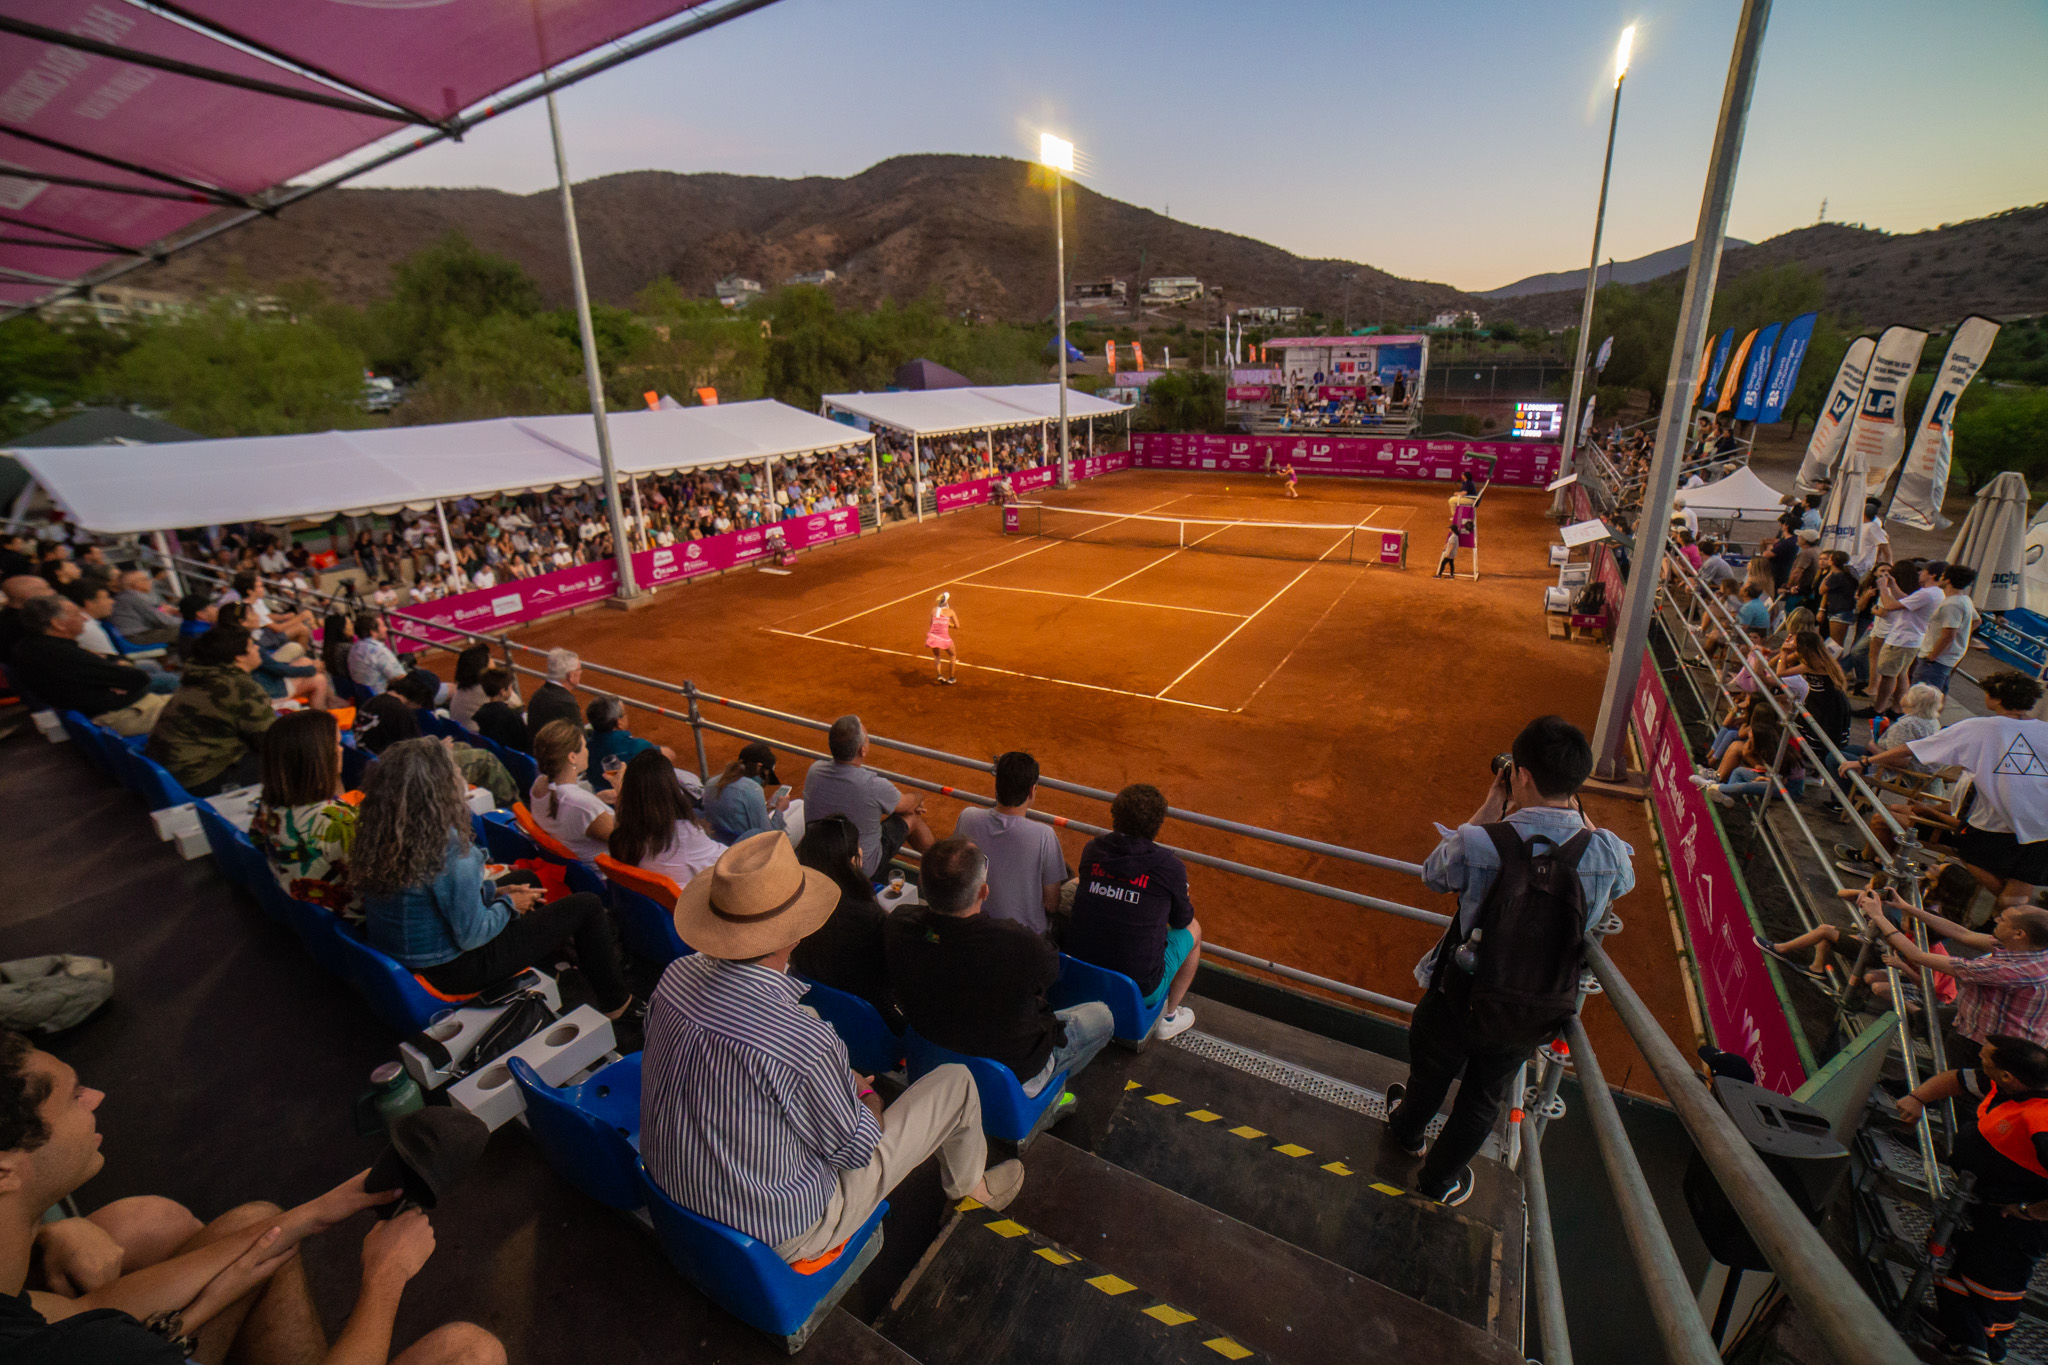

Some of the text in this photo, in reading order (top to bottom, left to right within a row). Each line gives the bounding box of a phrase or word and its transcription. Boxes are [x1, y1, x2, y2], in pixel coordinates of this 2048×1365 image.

[1864, 391, 1896, 414] LP
[1527, 411, 1533, 420] 6
[1232, 442, 1249, 453] LP
[1312, 444, 1330, 456] LP
[1399, 447, 1419, 459] LP
[1008, 515, 1017, 523] LP
[1384, 543, 1398, 552] LP
[588, 576, 602, 587] LP
[1660, 738, 1671, 769] LP
[1089, 881, 1124, 900] Mobil
